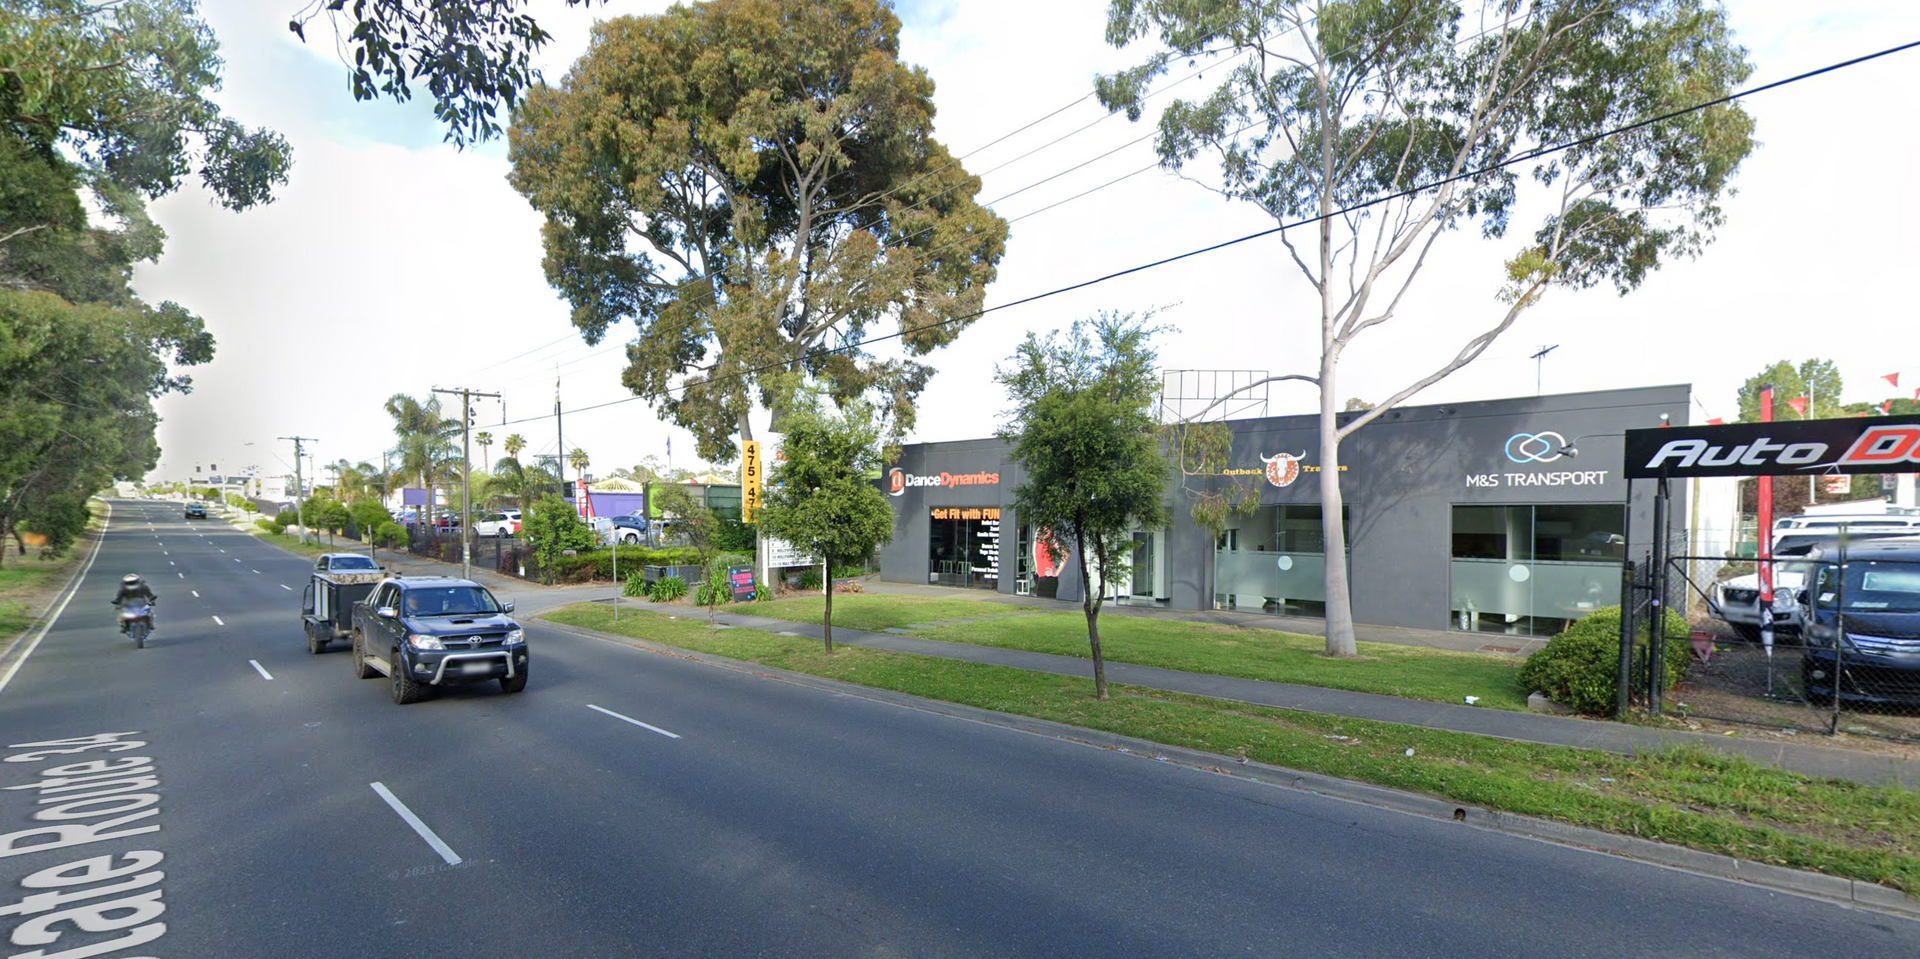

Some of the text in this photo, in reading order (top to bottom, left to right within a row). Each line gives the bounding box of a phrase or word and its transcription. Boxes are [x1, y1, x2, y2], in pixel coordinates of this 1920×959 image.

[1645, 437, 1829, 469] Auto
[1223, 464, 1349, 476] Outback Trars
[905, 471, 1000, 489] DanceDynamics
[1466, 471, 1609, 488] M&S TRANSPORT
[934, 508, 1000, 520] Get Fit with FUN
